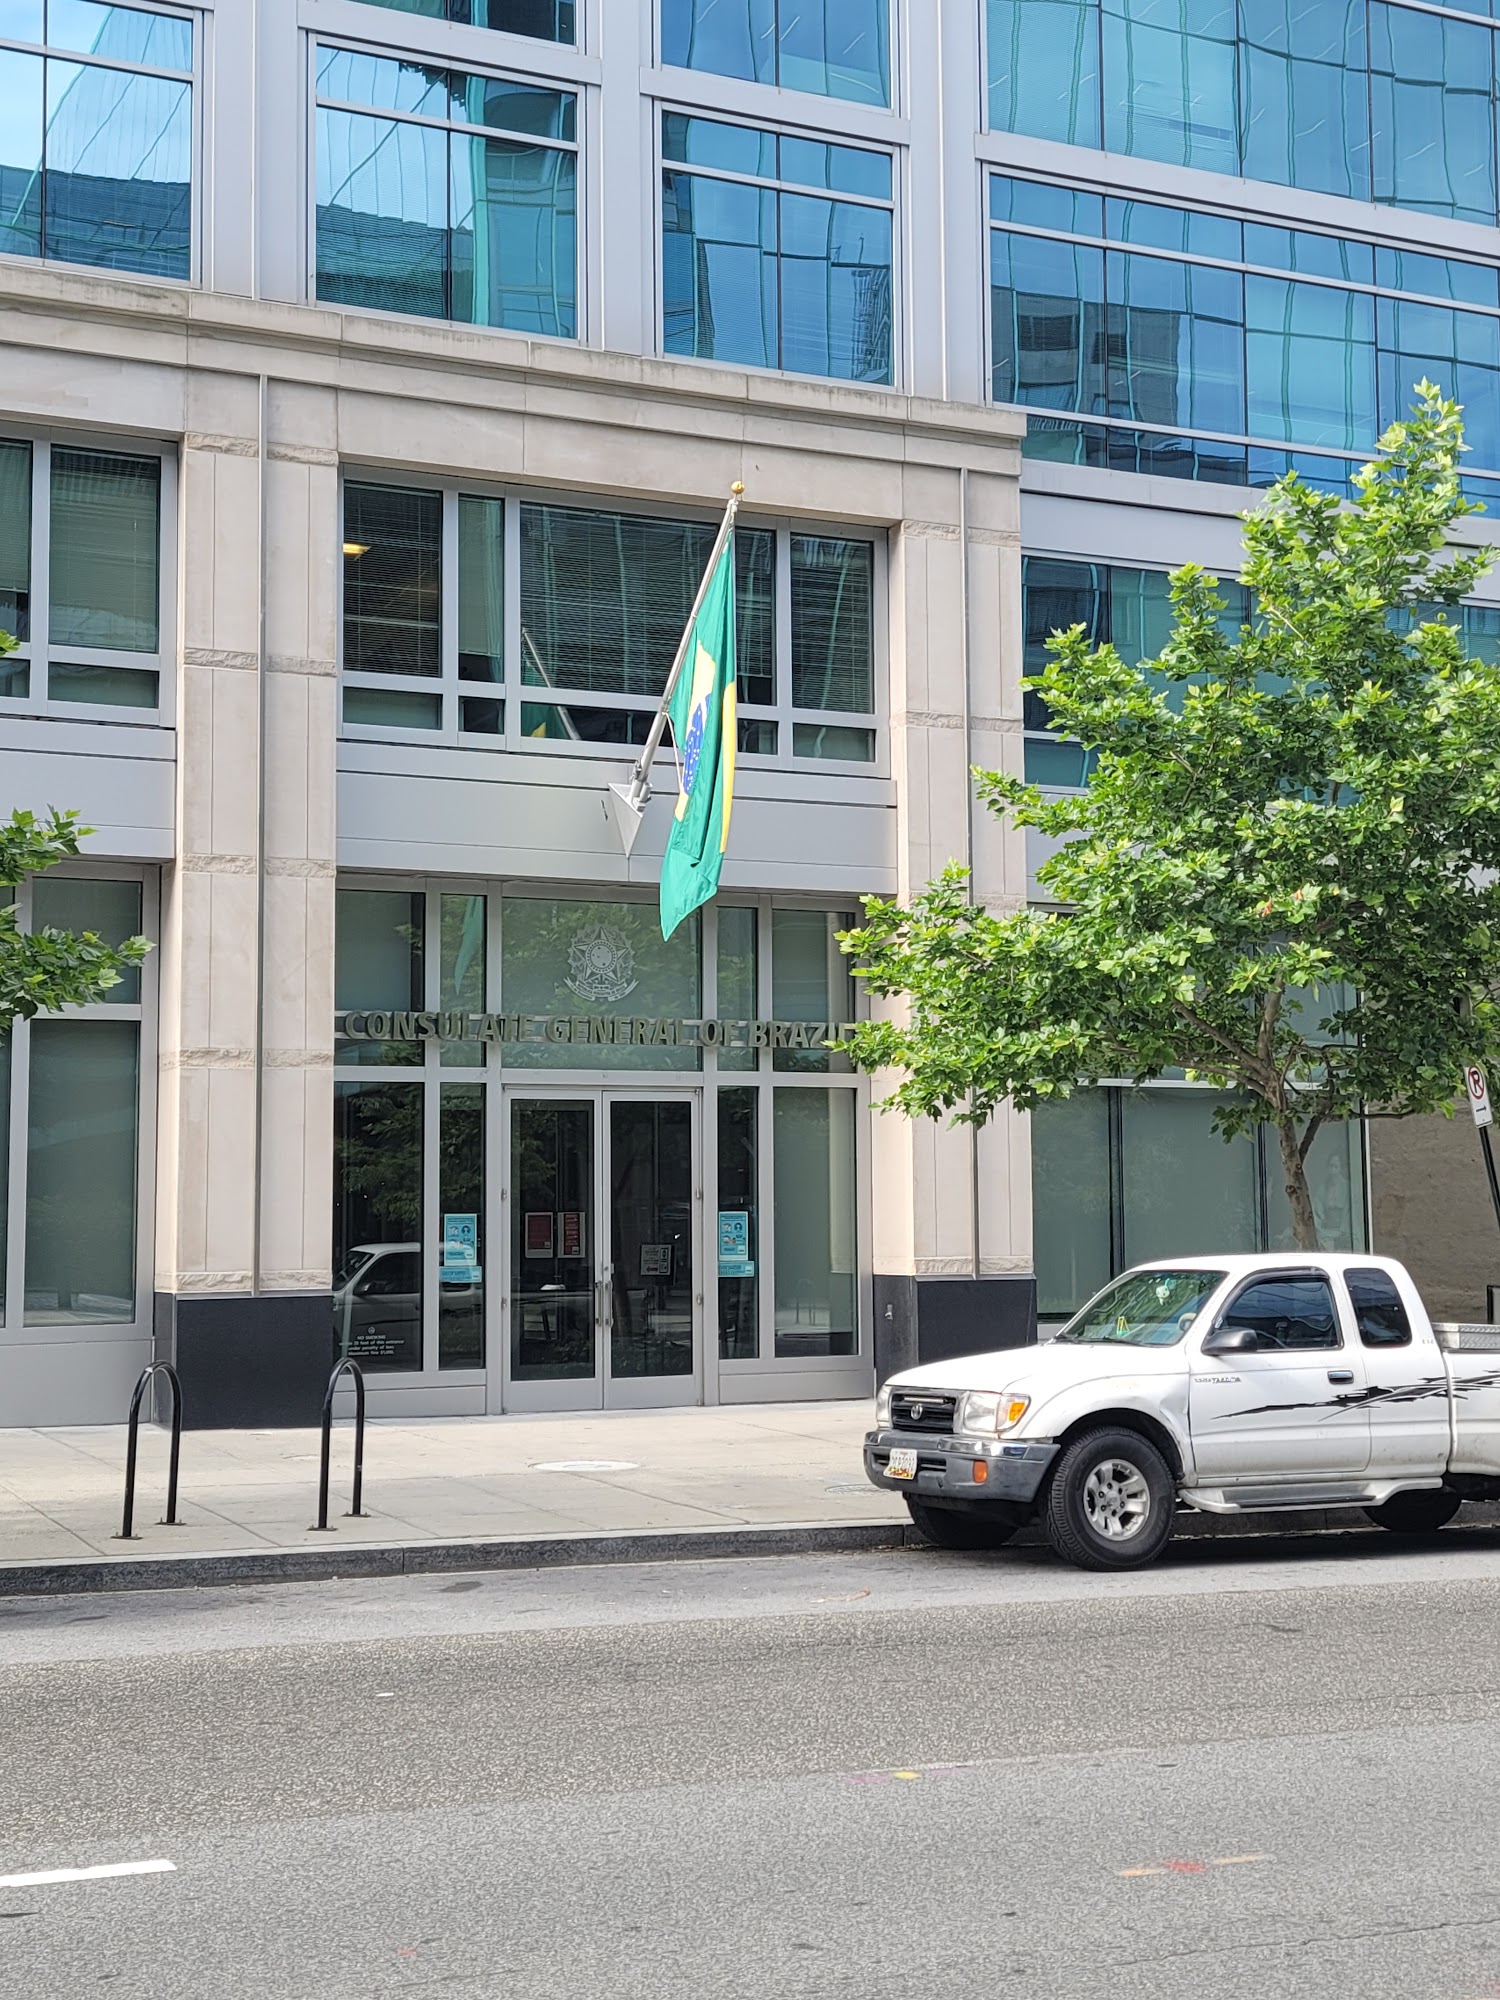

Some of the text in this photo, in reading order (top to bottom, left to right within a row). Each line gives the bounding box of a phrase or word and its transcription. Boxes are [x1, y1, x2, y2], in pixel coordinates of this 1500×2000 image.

[345, 1010, 536, 1042] CONSULATE
[545, 1014, 691, 1046] GENERAL
[700, 1018, 738, 1047] OF
